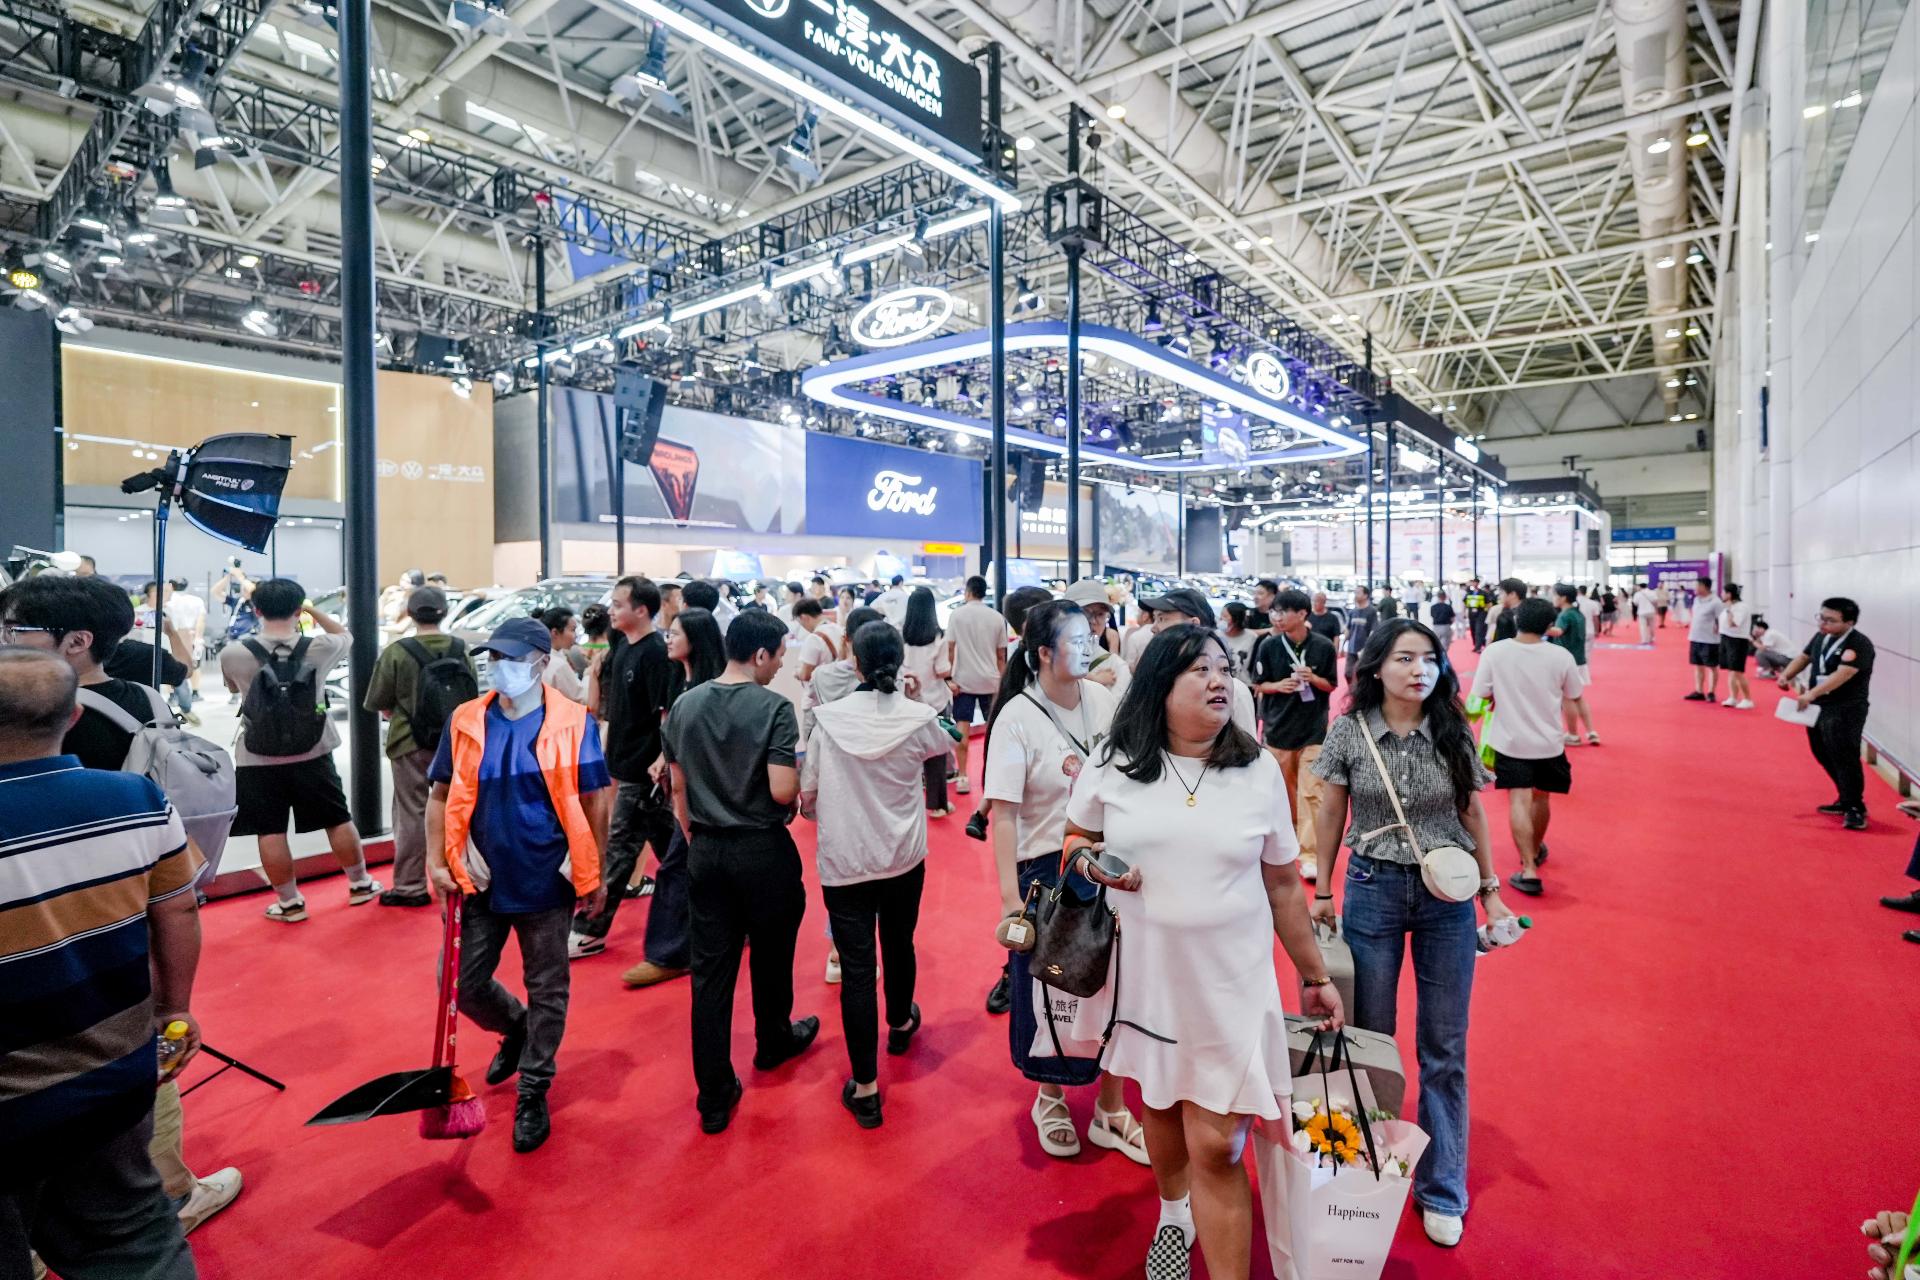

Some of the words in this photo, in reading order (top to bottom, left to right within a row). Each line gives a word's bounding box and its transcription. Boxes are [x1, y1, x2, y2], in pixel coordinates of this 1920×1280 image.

[804, 19, 943, 118] FAW-VOLKSWAGEN
[869, 297, 932, 339] Ford
[867, 470, 938, 516] Ford
[1328, 1204, 1380, 1221] Happiness
